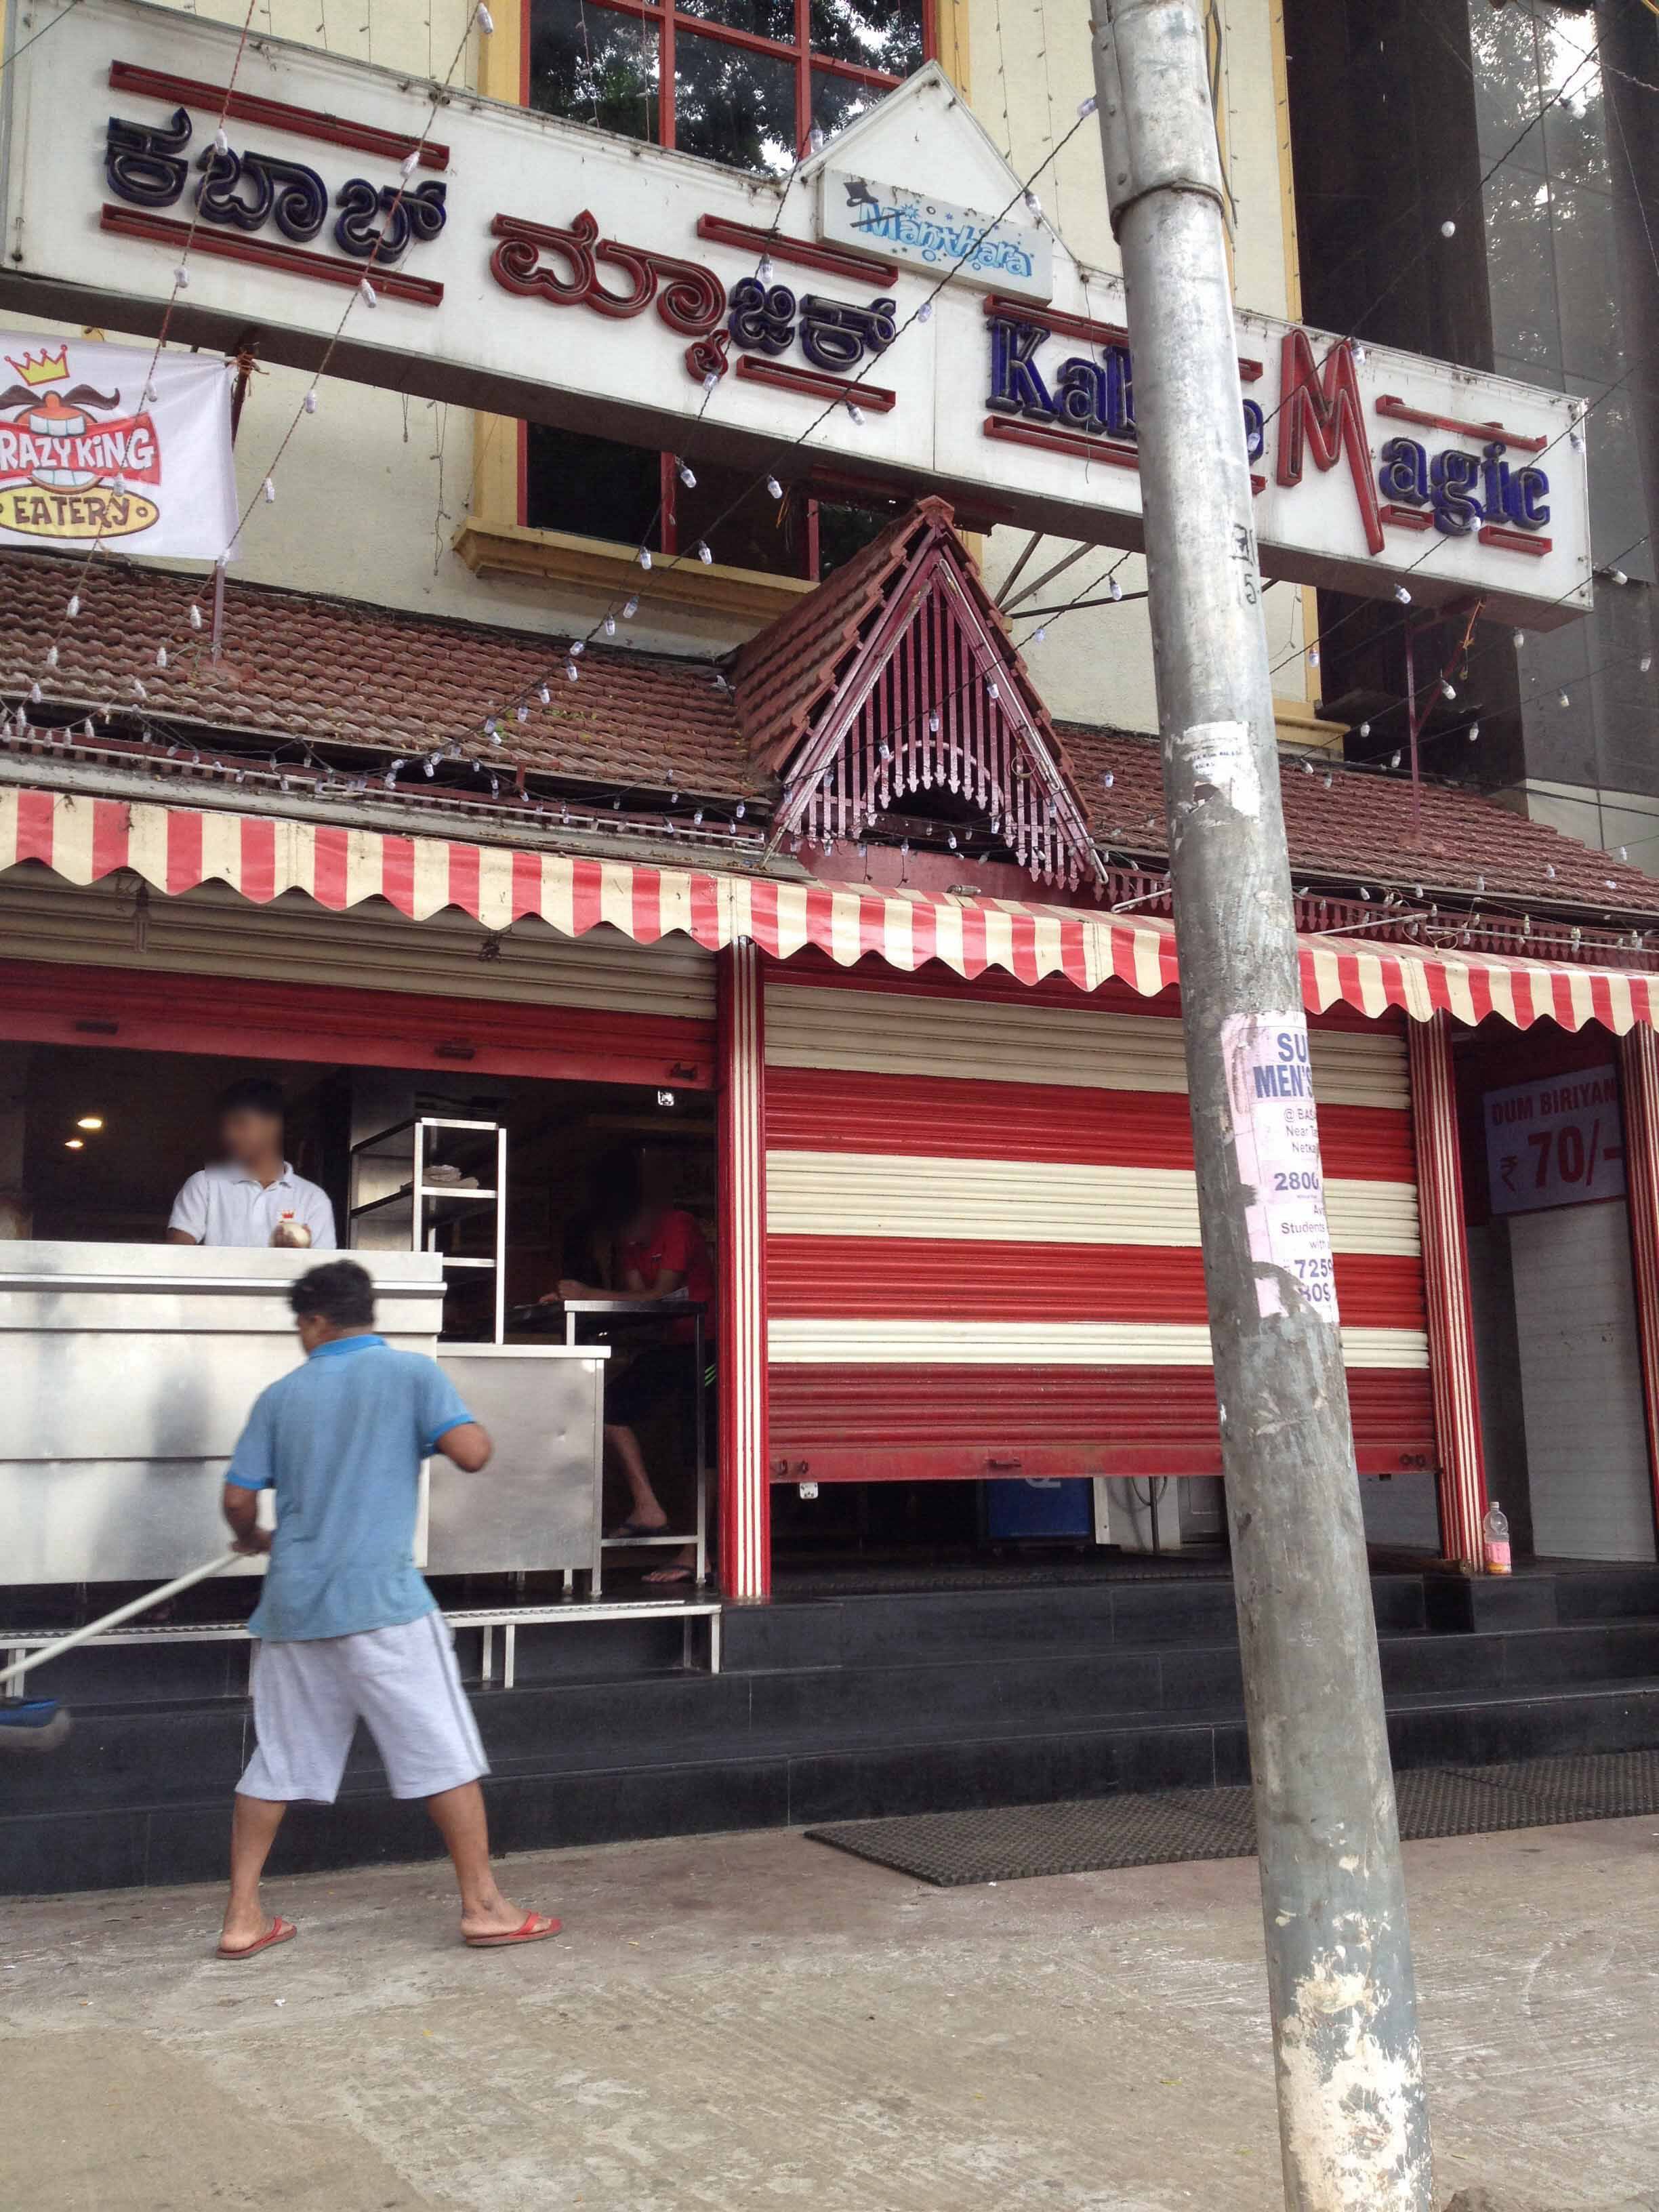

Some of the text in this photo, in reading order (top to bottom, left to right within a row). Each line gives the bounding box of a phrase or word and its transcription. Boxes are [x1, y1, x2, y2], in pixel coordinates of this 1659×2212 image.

[857, 203, 1032, 276] Manthara
[1277, 329, 1551, 556] Magic
[14, 495, 130, 528] EATERY
[1492, 1095, 1534, 1126] DUM
[1286, 1125, 1308, 1137] Near
[1281, 1222, 1326, 1234] Students
